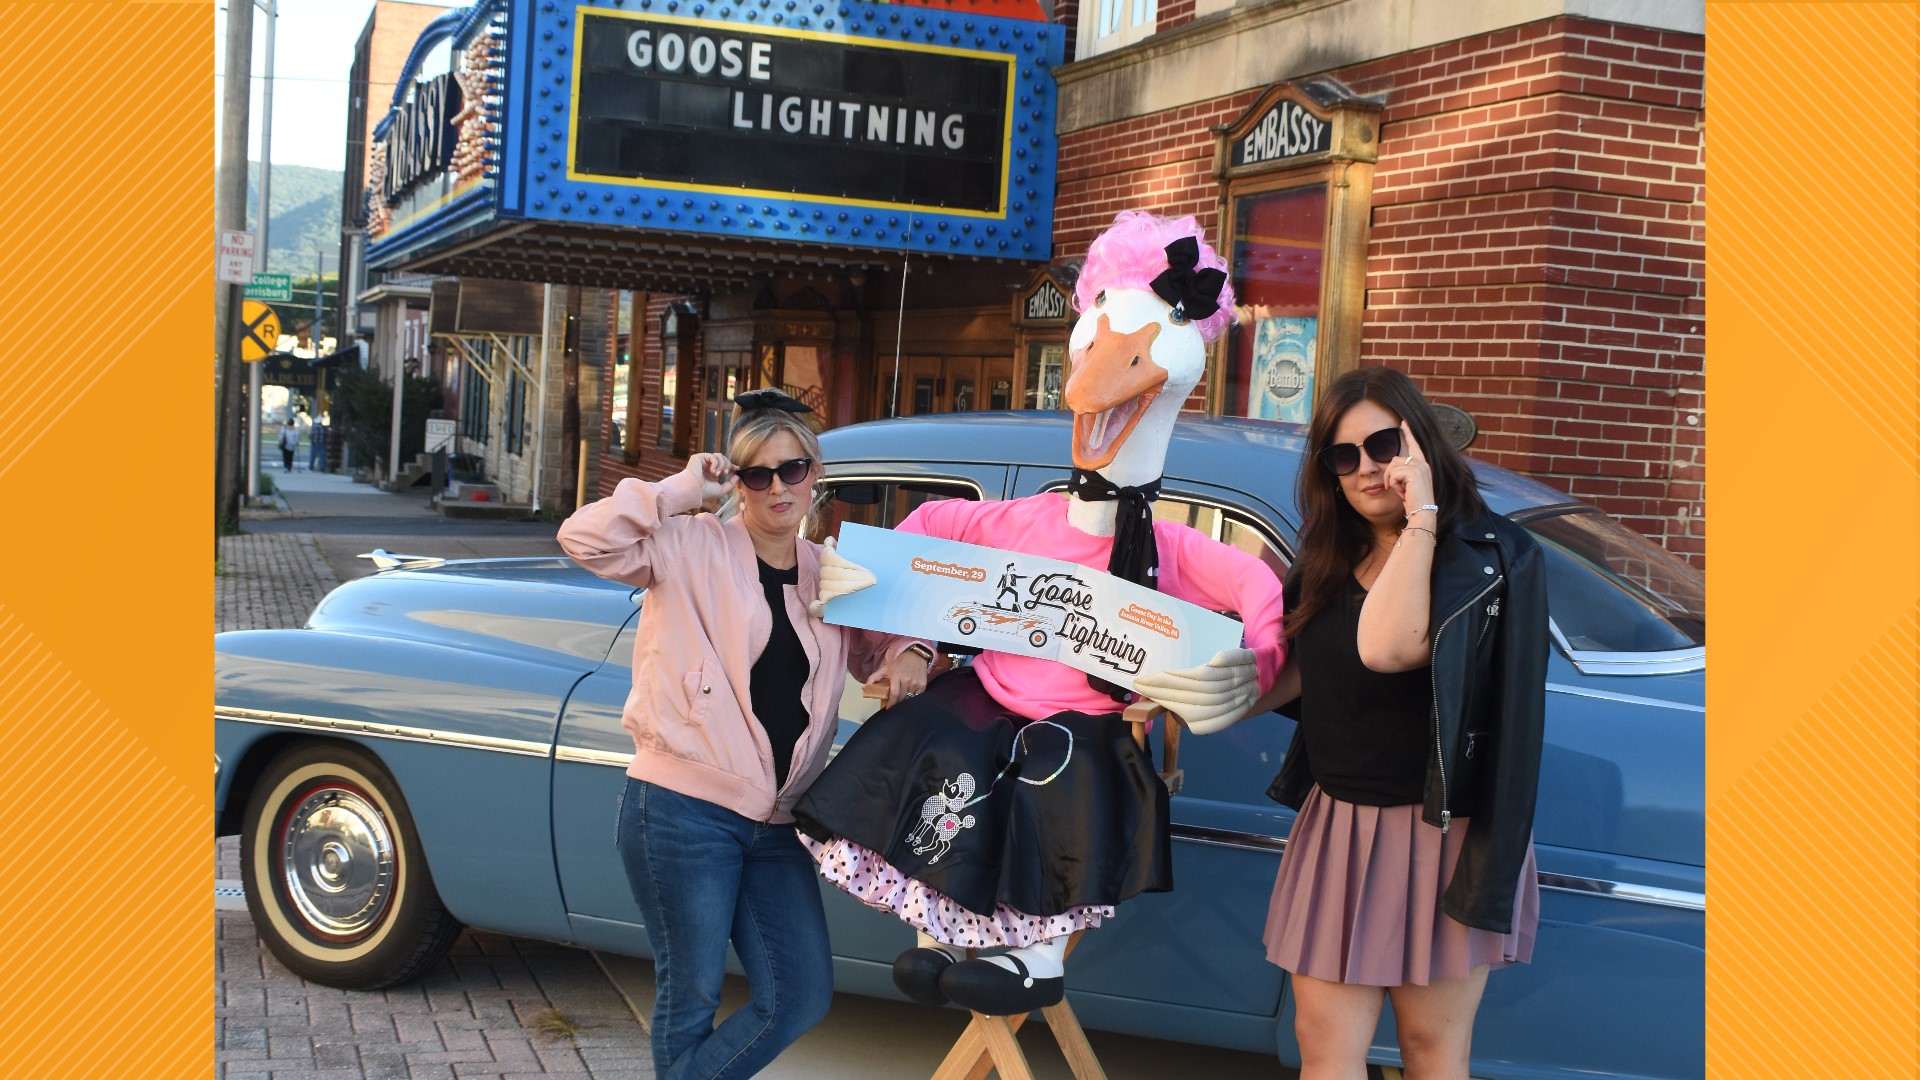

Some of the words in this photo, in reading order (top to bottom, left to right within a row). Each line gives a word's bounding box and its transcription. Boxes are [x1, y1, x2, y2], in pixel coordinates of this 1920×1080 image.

[627, 29, 772, 81] GOOSE
[733, 91, 965, 150] LIGHTNING
[1242, 101, 1324, 164] EMBASSY
[231, 234, 245, 245] NO
[220, 246, 253, 258] PARKING
[228, 268, 243, 277] TIME
[252, 275, 288, 288] College
[244, 287, 288, 299] arrisburg
[1028, 281, 1065, 318] EMBASSY
[263, 324, 275, 339] R
[1269, 366, 1304, 389] Bambi
[914, 560, 970, 578] September,
[971, 570, 984, 579] 29
[1024, 573, 1093, 611] Goose
[1131, 605, 1147, 616] Goose
[1147, 612, 1156, 620] Day
[1140, 618, 1154, 627] River
[1055, 609, 1147, 675] Lightning
